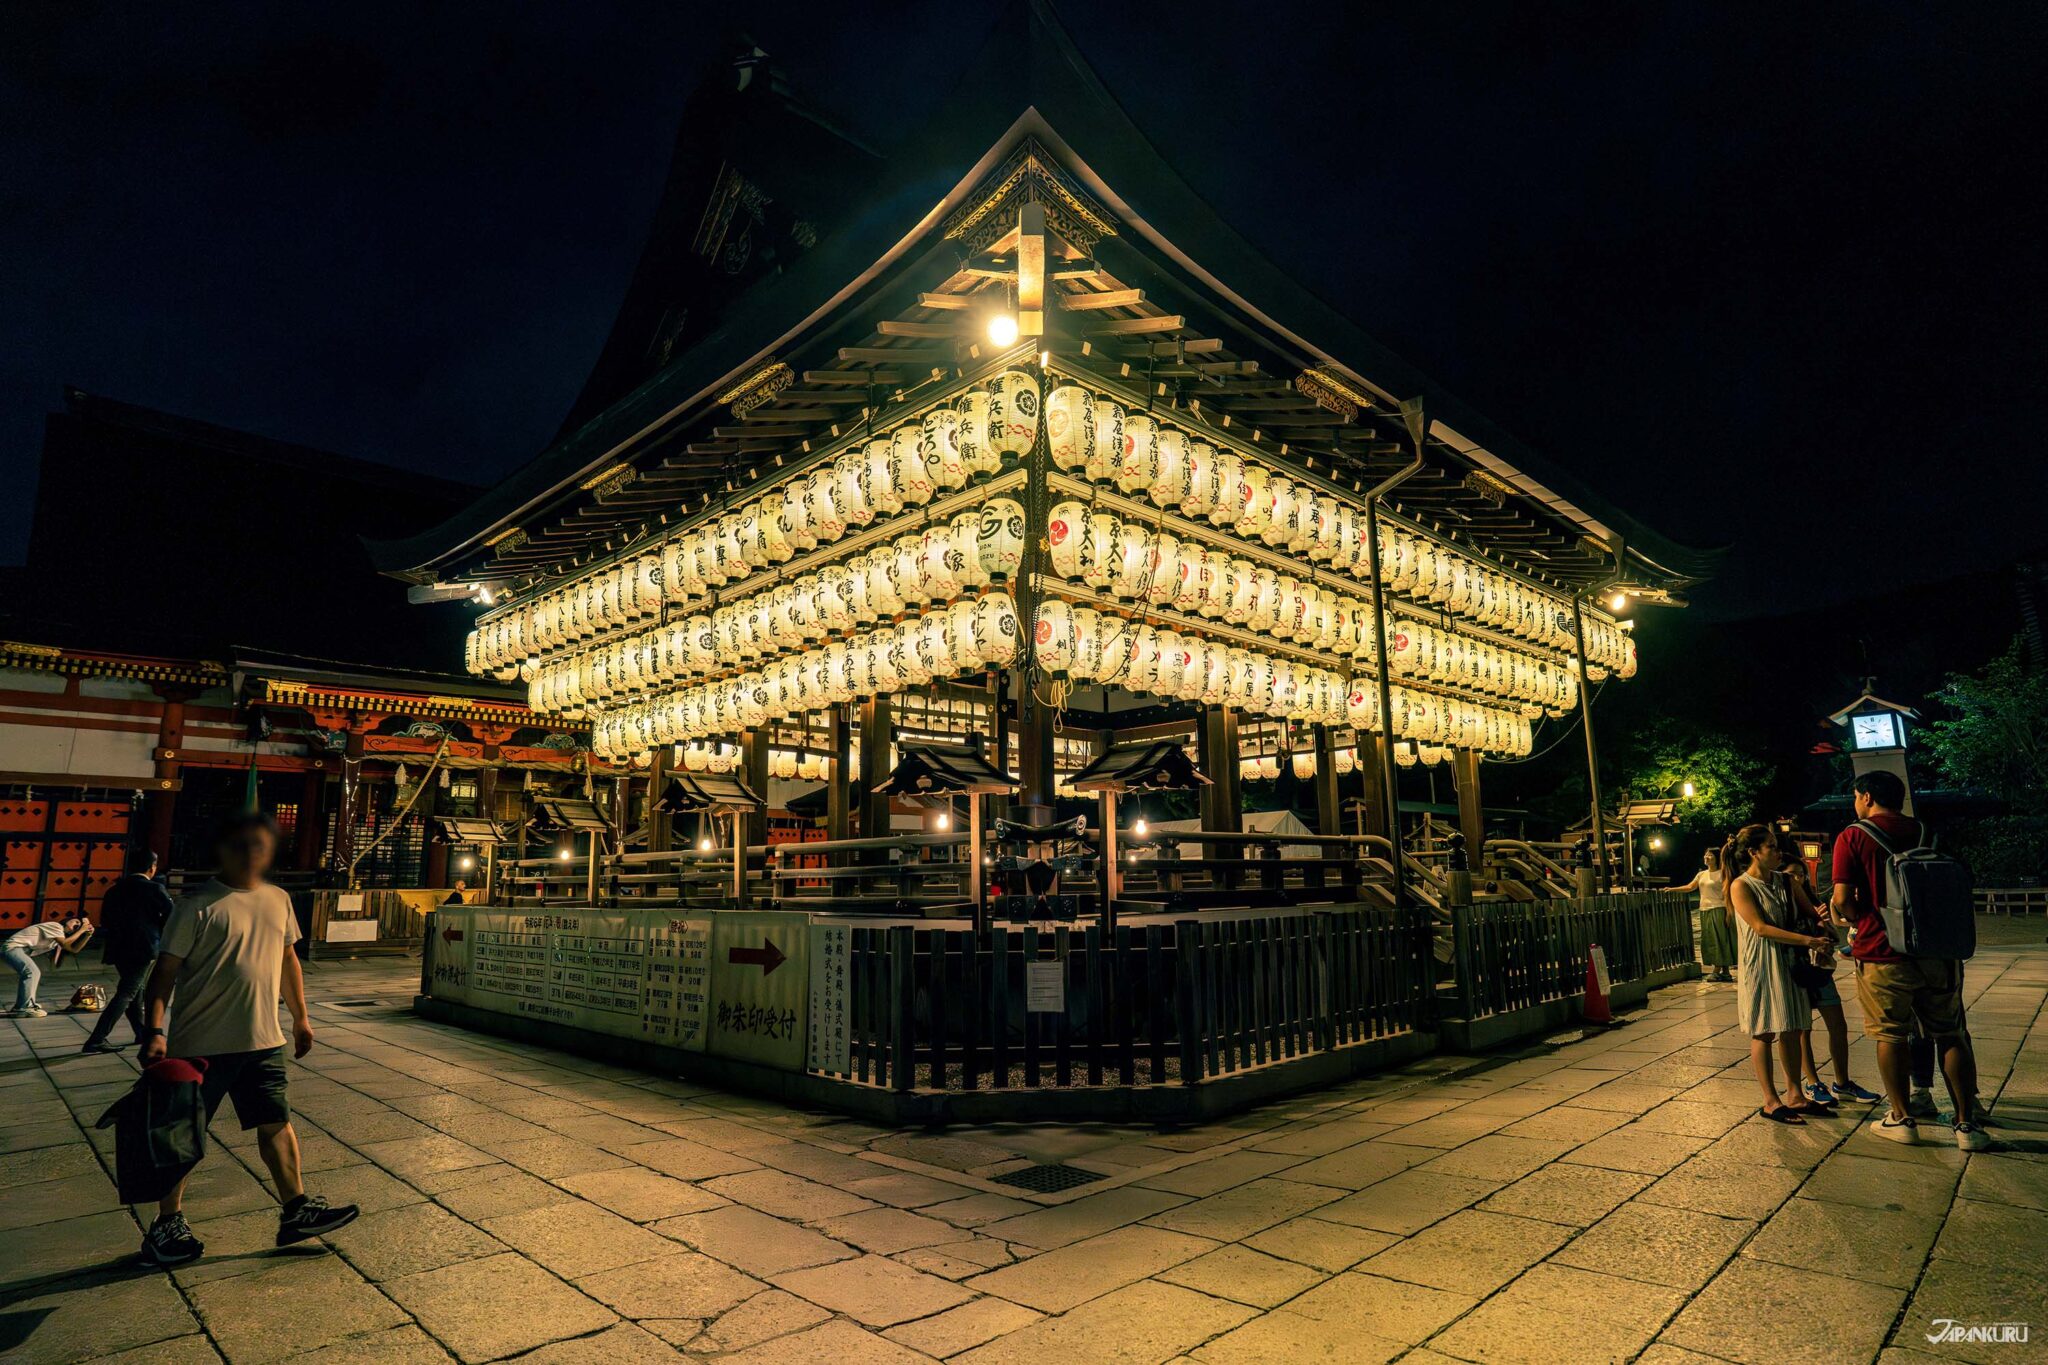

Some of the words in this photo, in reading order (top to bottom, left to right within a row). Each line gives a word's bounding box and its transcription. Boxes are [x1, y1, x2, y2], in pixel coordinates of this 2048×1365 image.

[717, 999, 797, 1042] 御朱印受付
[823, 929, 833, 1066] 結婚式をお受けします
